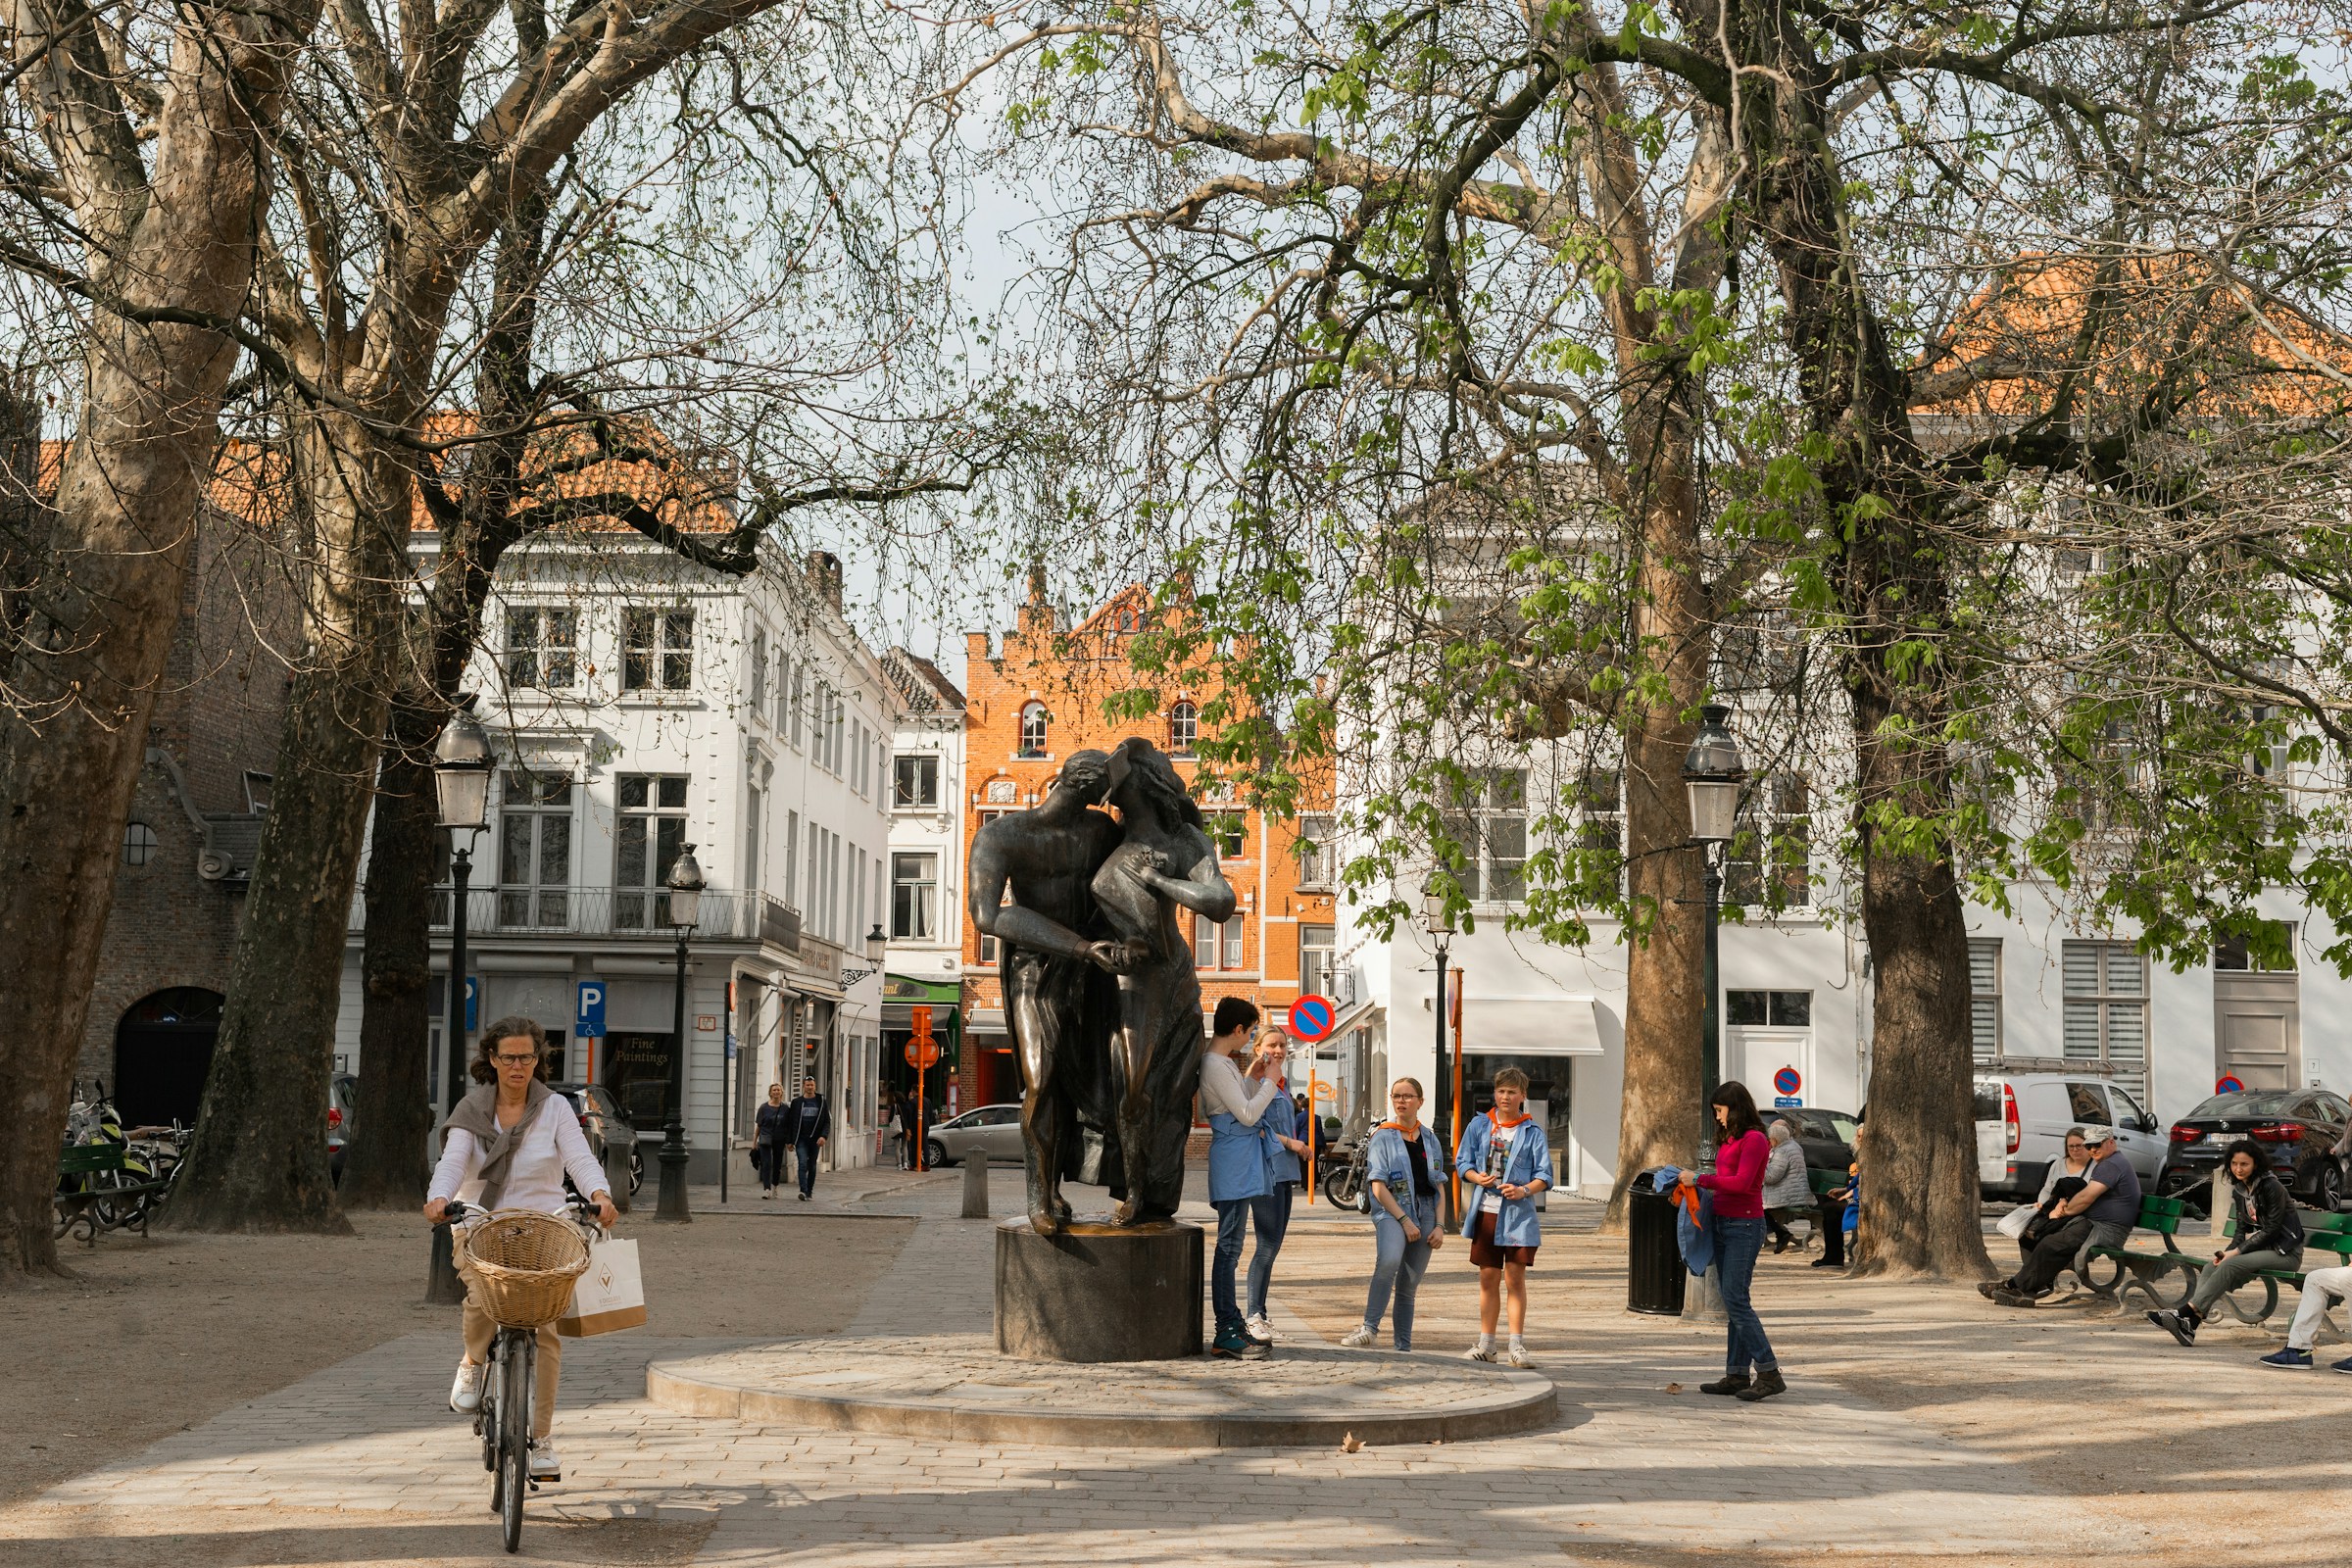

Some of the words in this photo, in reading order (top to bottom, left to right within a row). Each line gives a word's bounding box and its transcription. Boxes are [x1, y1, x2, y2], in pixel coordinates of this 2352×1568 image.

[581, 988, 601, 1016] P
[631, 1037, 656, 1050] Fine
[615, 1051, 668, 1066] Paintings
[602, 1276, 611, 1288] V
